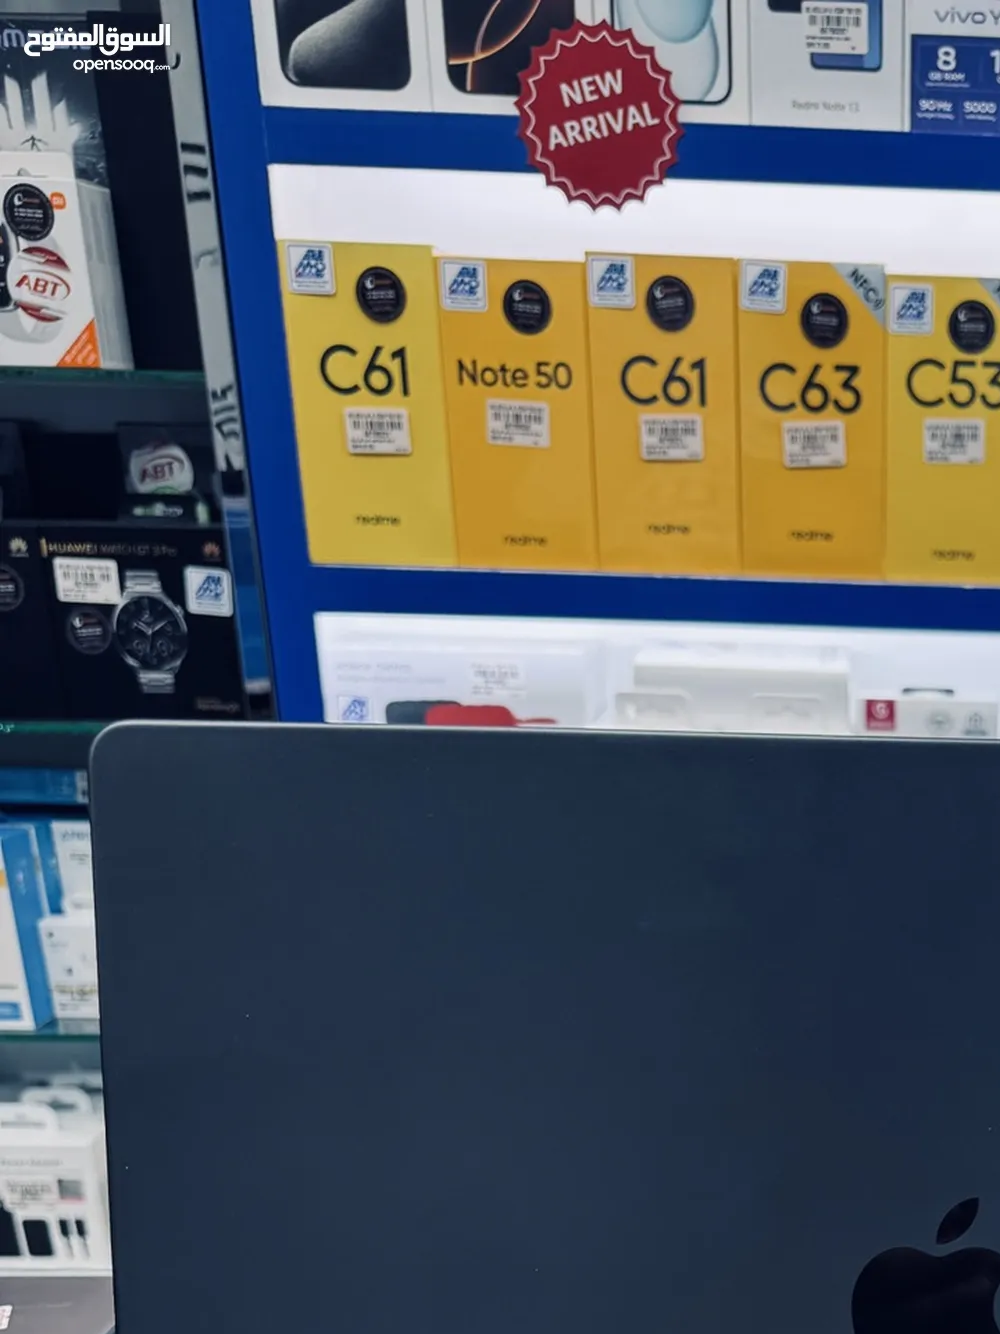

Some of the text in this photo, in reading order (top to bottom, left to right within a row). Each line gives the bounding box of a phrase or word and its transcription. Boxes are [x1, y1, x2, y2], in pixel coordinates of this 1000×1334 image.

[934, 9, 986, 25] vivo
[936, 45, 957, 71] 8
[558, 68, 626, 108] NEW
[547, 103, 661, 152] ARRIVAL
[15, 273, 63, 298] ABT
[319, 343, 411, 398] C61
[456, 359, 573, 390] Note 50
[620, 354, 708, 408] C61
[758, 361, 863, 414] C63
[48, 542, 97, 555] HUAWEI
